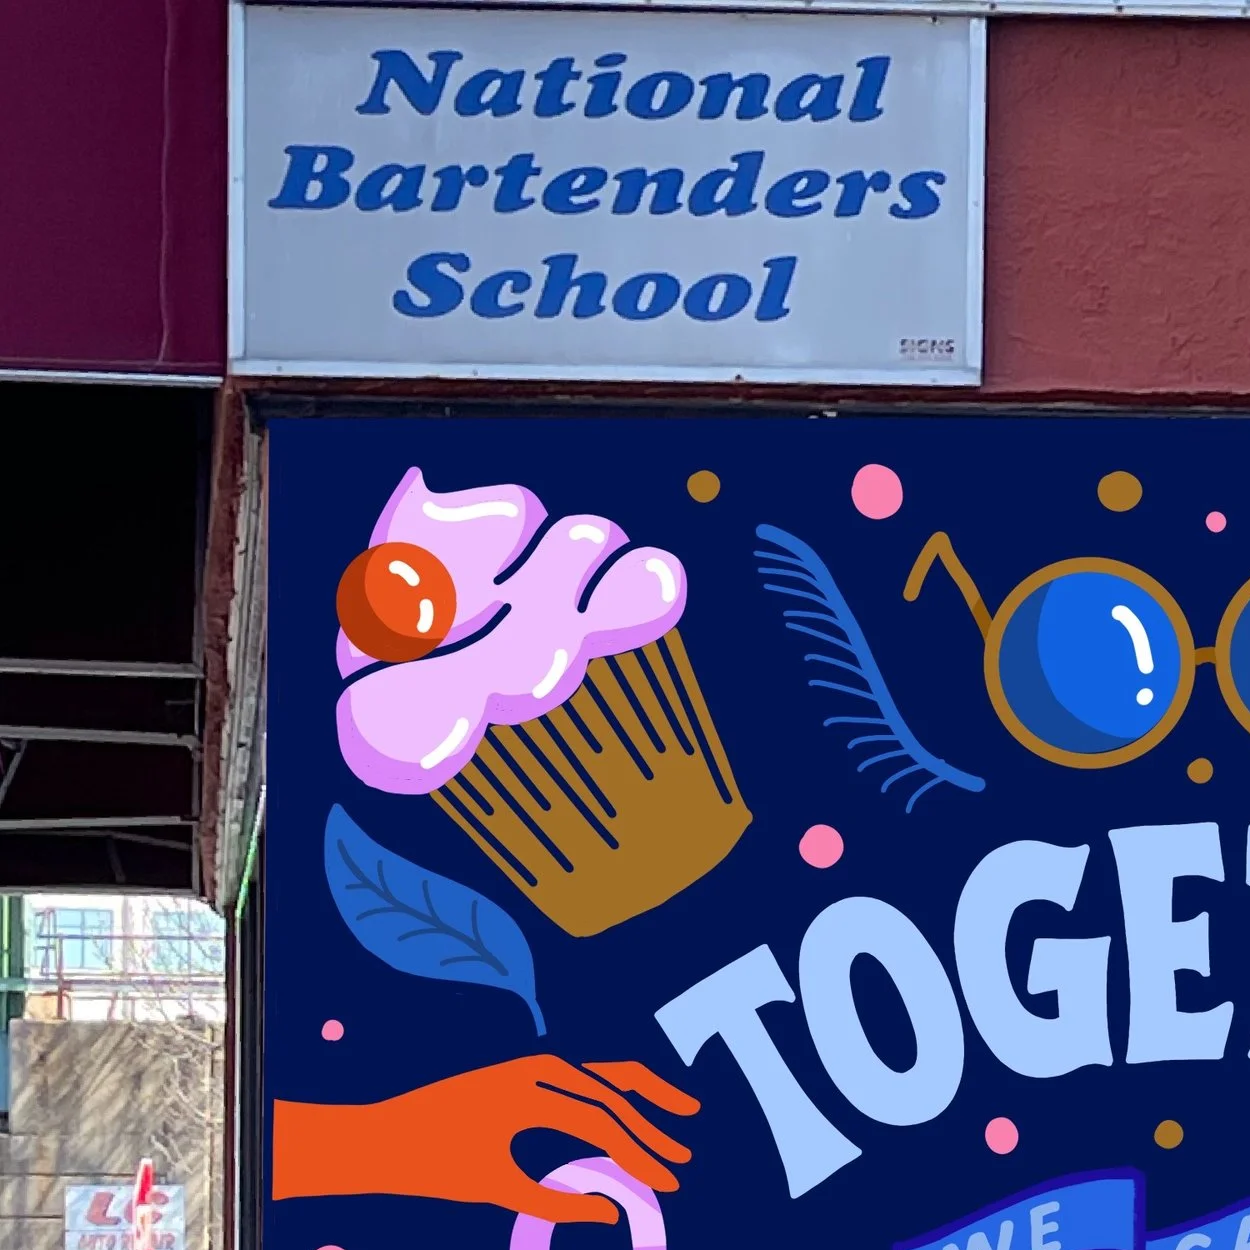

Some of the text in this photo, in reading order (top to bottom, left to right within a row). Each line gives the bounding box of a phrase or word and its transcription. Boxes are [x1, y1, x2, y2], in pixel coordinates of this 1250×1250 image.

[356, 50, 890, 122] National
[269, 145, 946, 219] Bartenders
[393, 252, 797, 321] School
